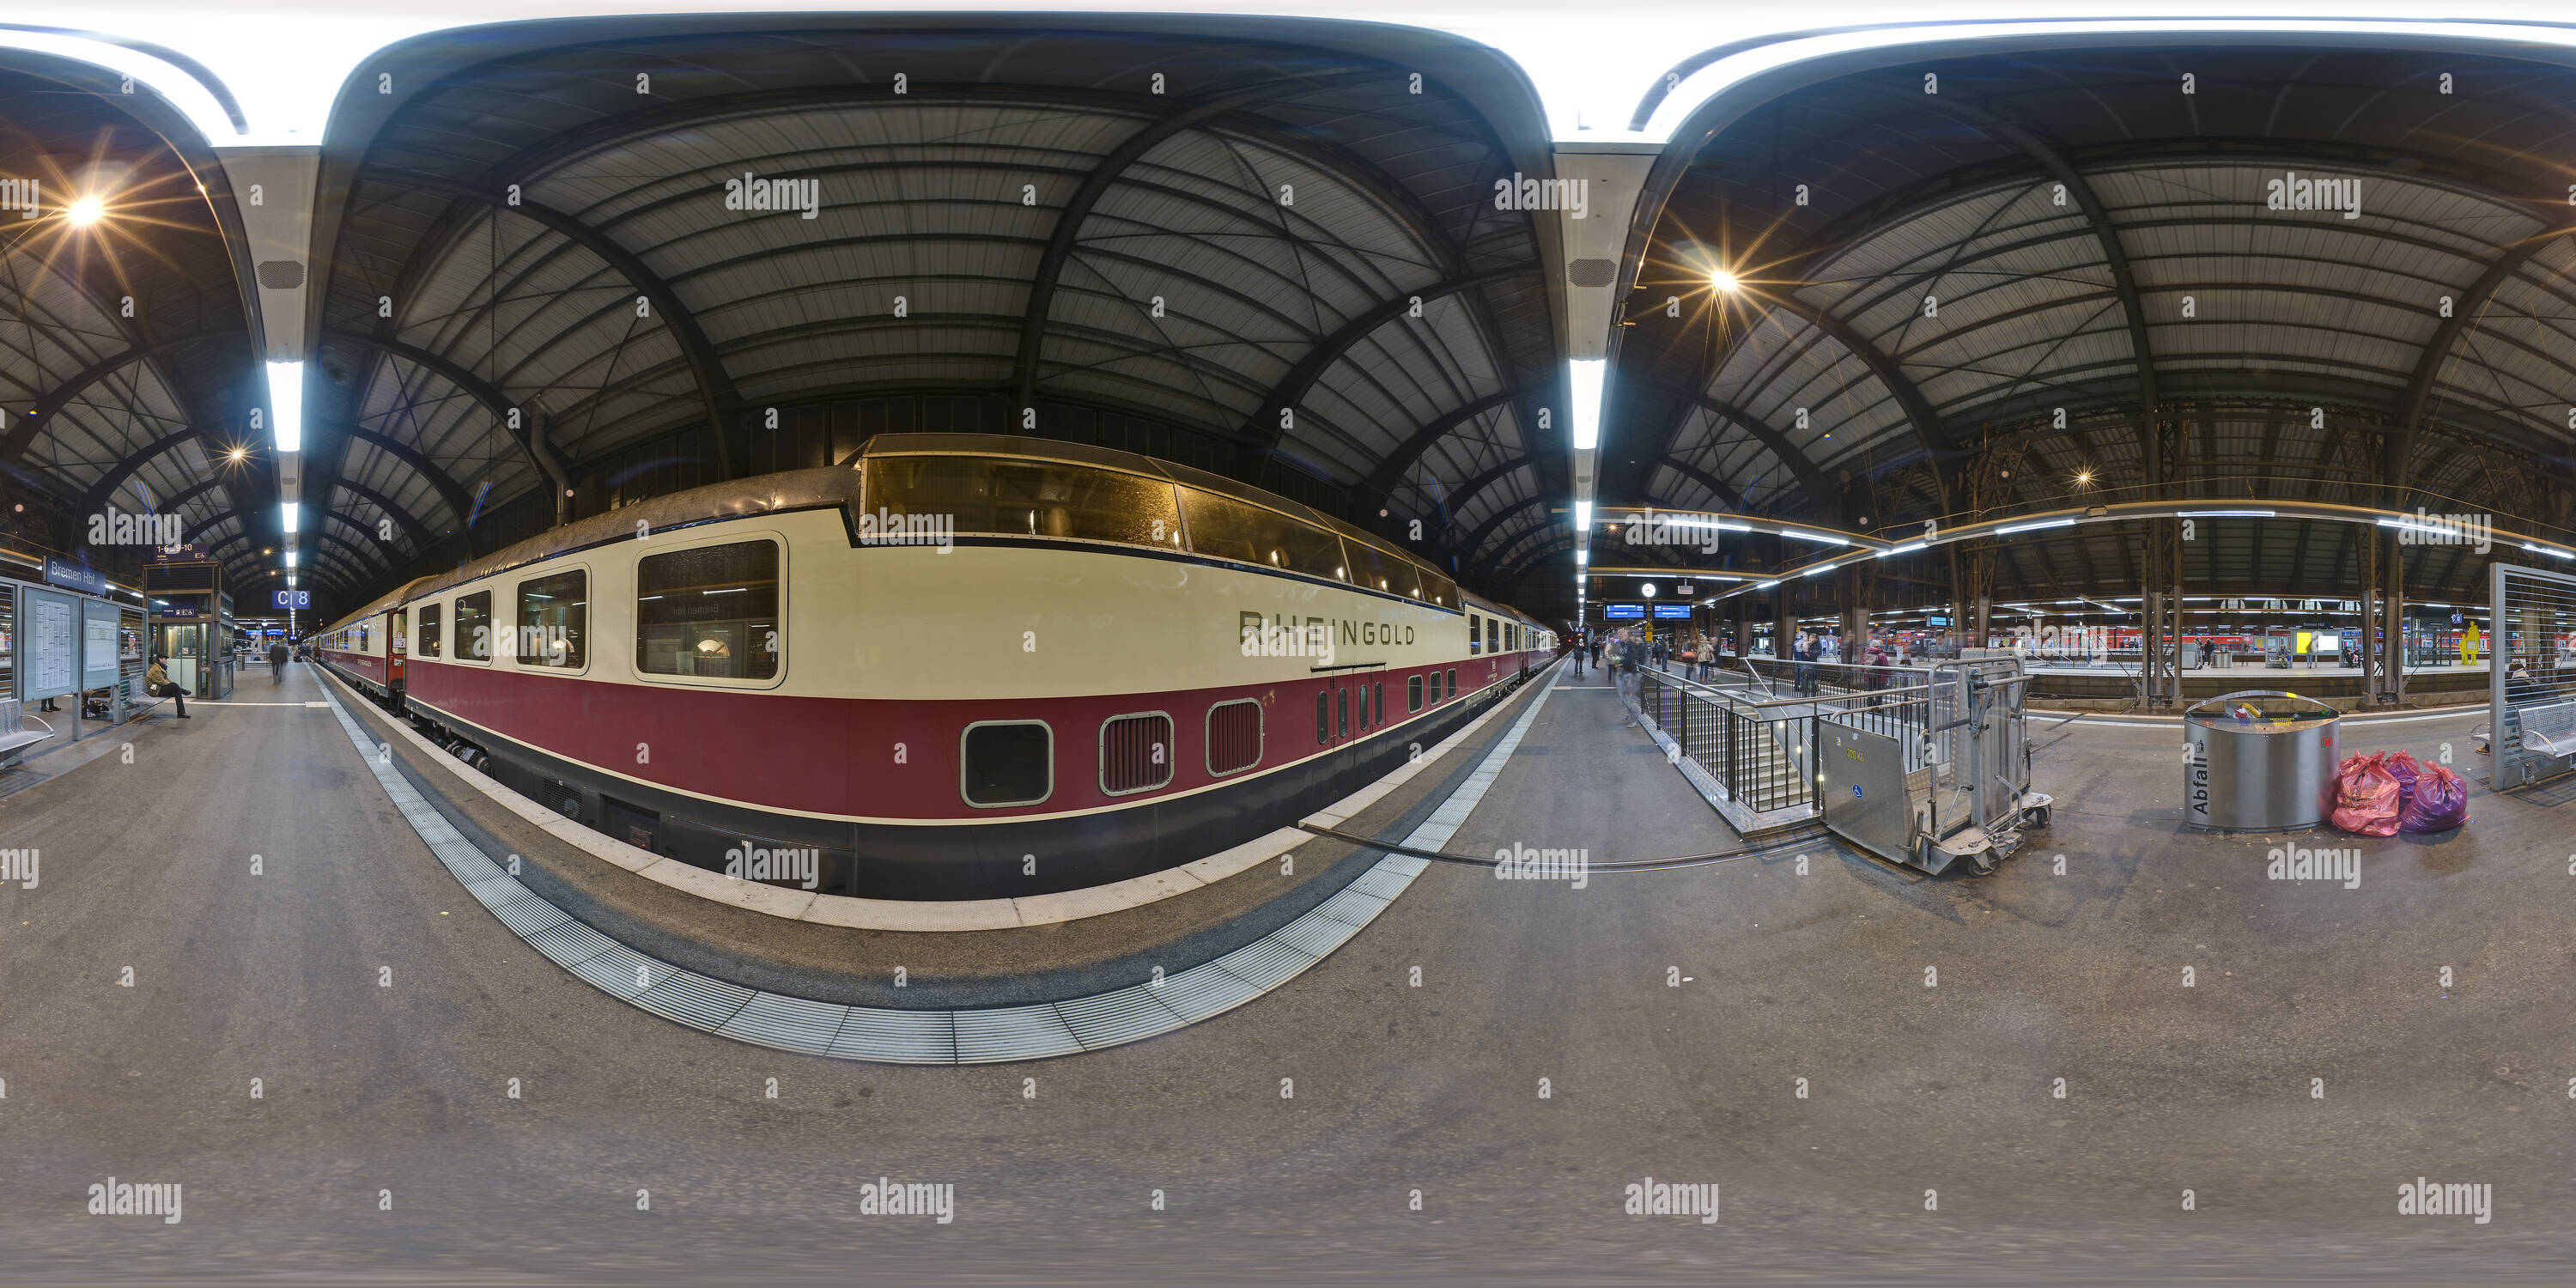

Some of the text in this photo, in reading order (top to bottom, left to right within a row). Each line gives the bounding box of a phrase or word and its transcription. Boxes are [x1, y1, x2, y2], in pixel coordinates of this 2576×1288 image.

[52, 561, 95, 586] Bremen Hbf
[277, 591, 308, 605] C 8
[1239, 611, 1414, 646] RHEINGOLD
[1847, 748, 1866, 762] 320 KG
[2192, 756, 2208, 816] Abfall
